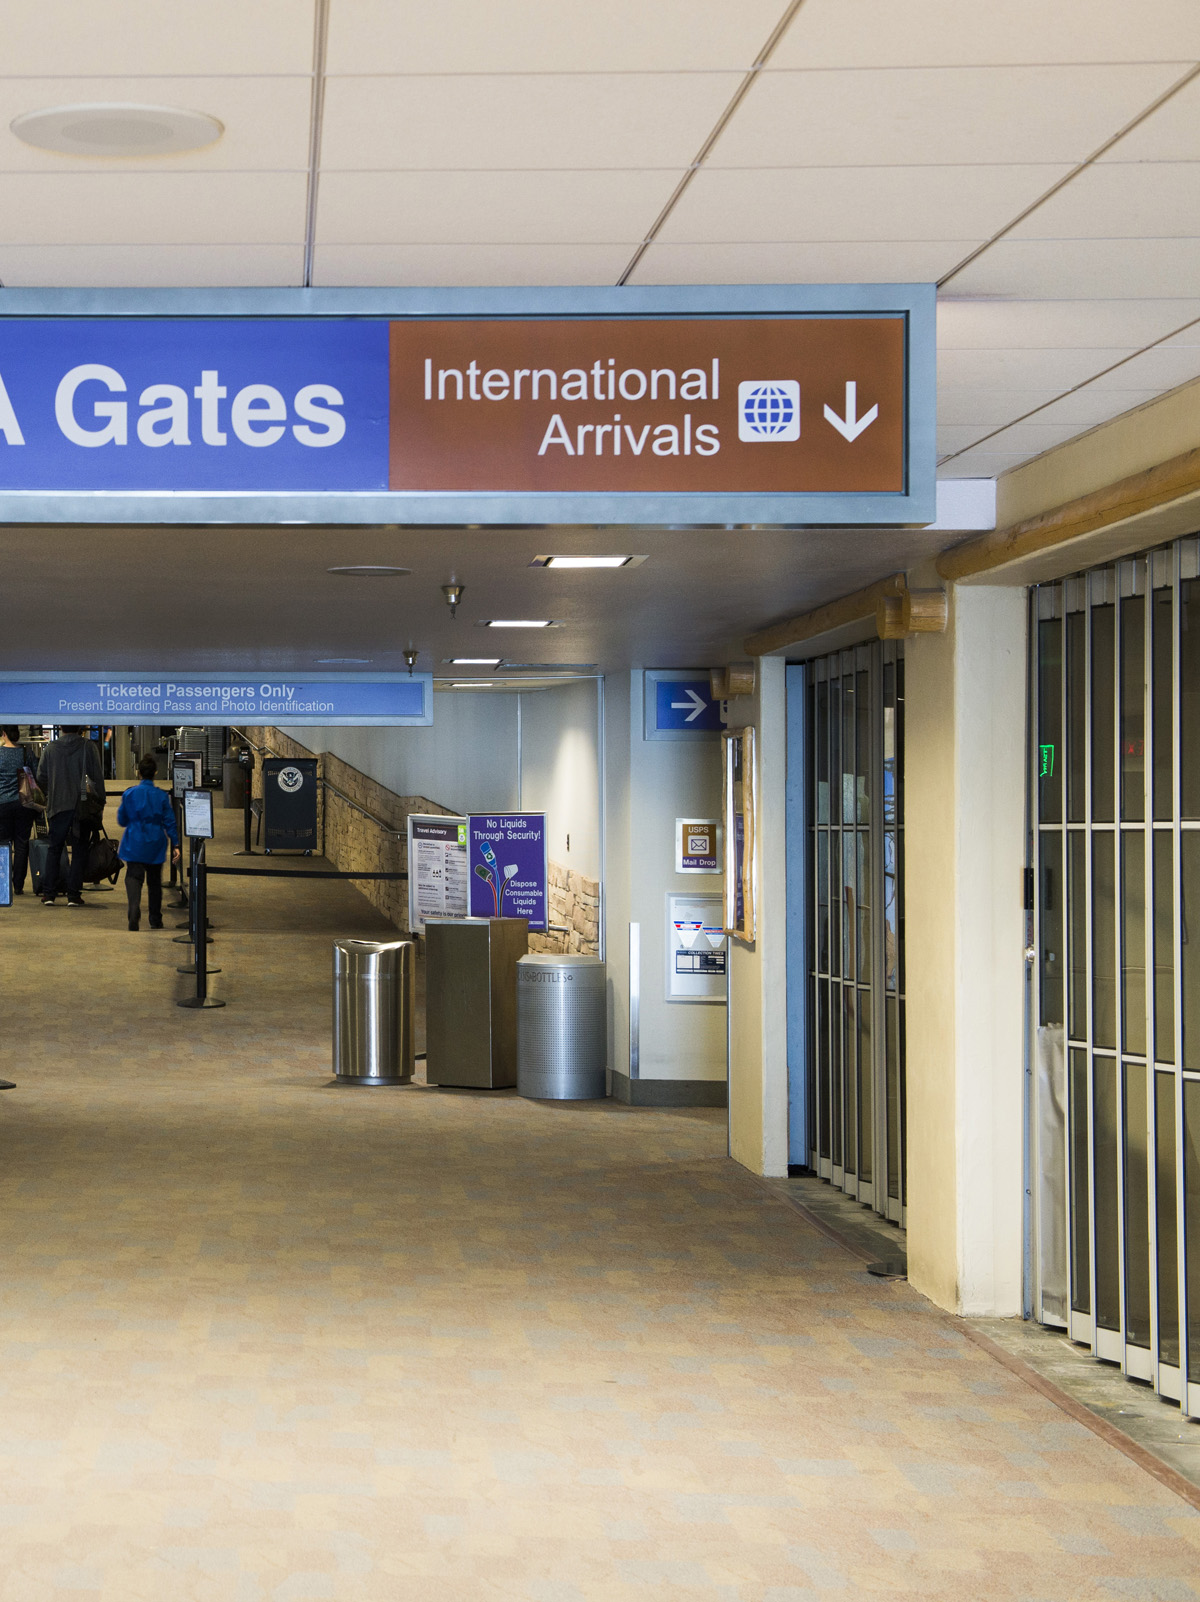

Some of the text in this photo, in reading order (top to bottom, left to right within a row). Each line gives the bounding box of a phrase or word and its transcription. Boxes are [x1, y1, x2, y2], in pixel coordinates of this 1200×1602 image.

[424, 358, 719, 401] International
[54, 363, 347, 448] Gates
[537, 414, 721, 457] Arrivals
[97, 684, 295, 700] Ticketed Passengers Only
[59, 699, 334, 714] Present Boarding Pass and Photo Identification
[486, 818, 527, 829] No Liquids
[430, 828, 448, 836] Advisory
[473, 830, 541, 842] Through Security!
[699, 859, 716, 867] Drop
[510, 880, 538, 888] Dispose
[504, 889, 543, 897] Consumable
[512, 897, 537, 906] Liquids
[516, 907, 533, 915] Here
[531, 972, 567, 983] BOTTLES
